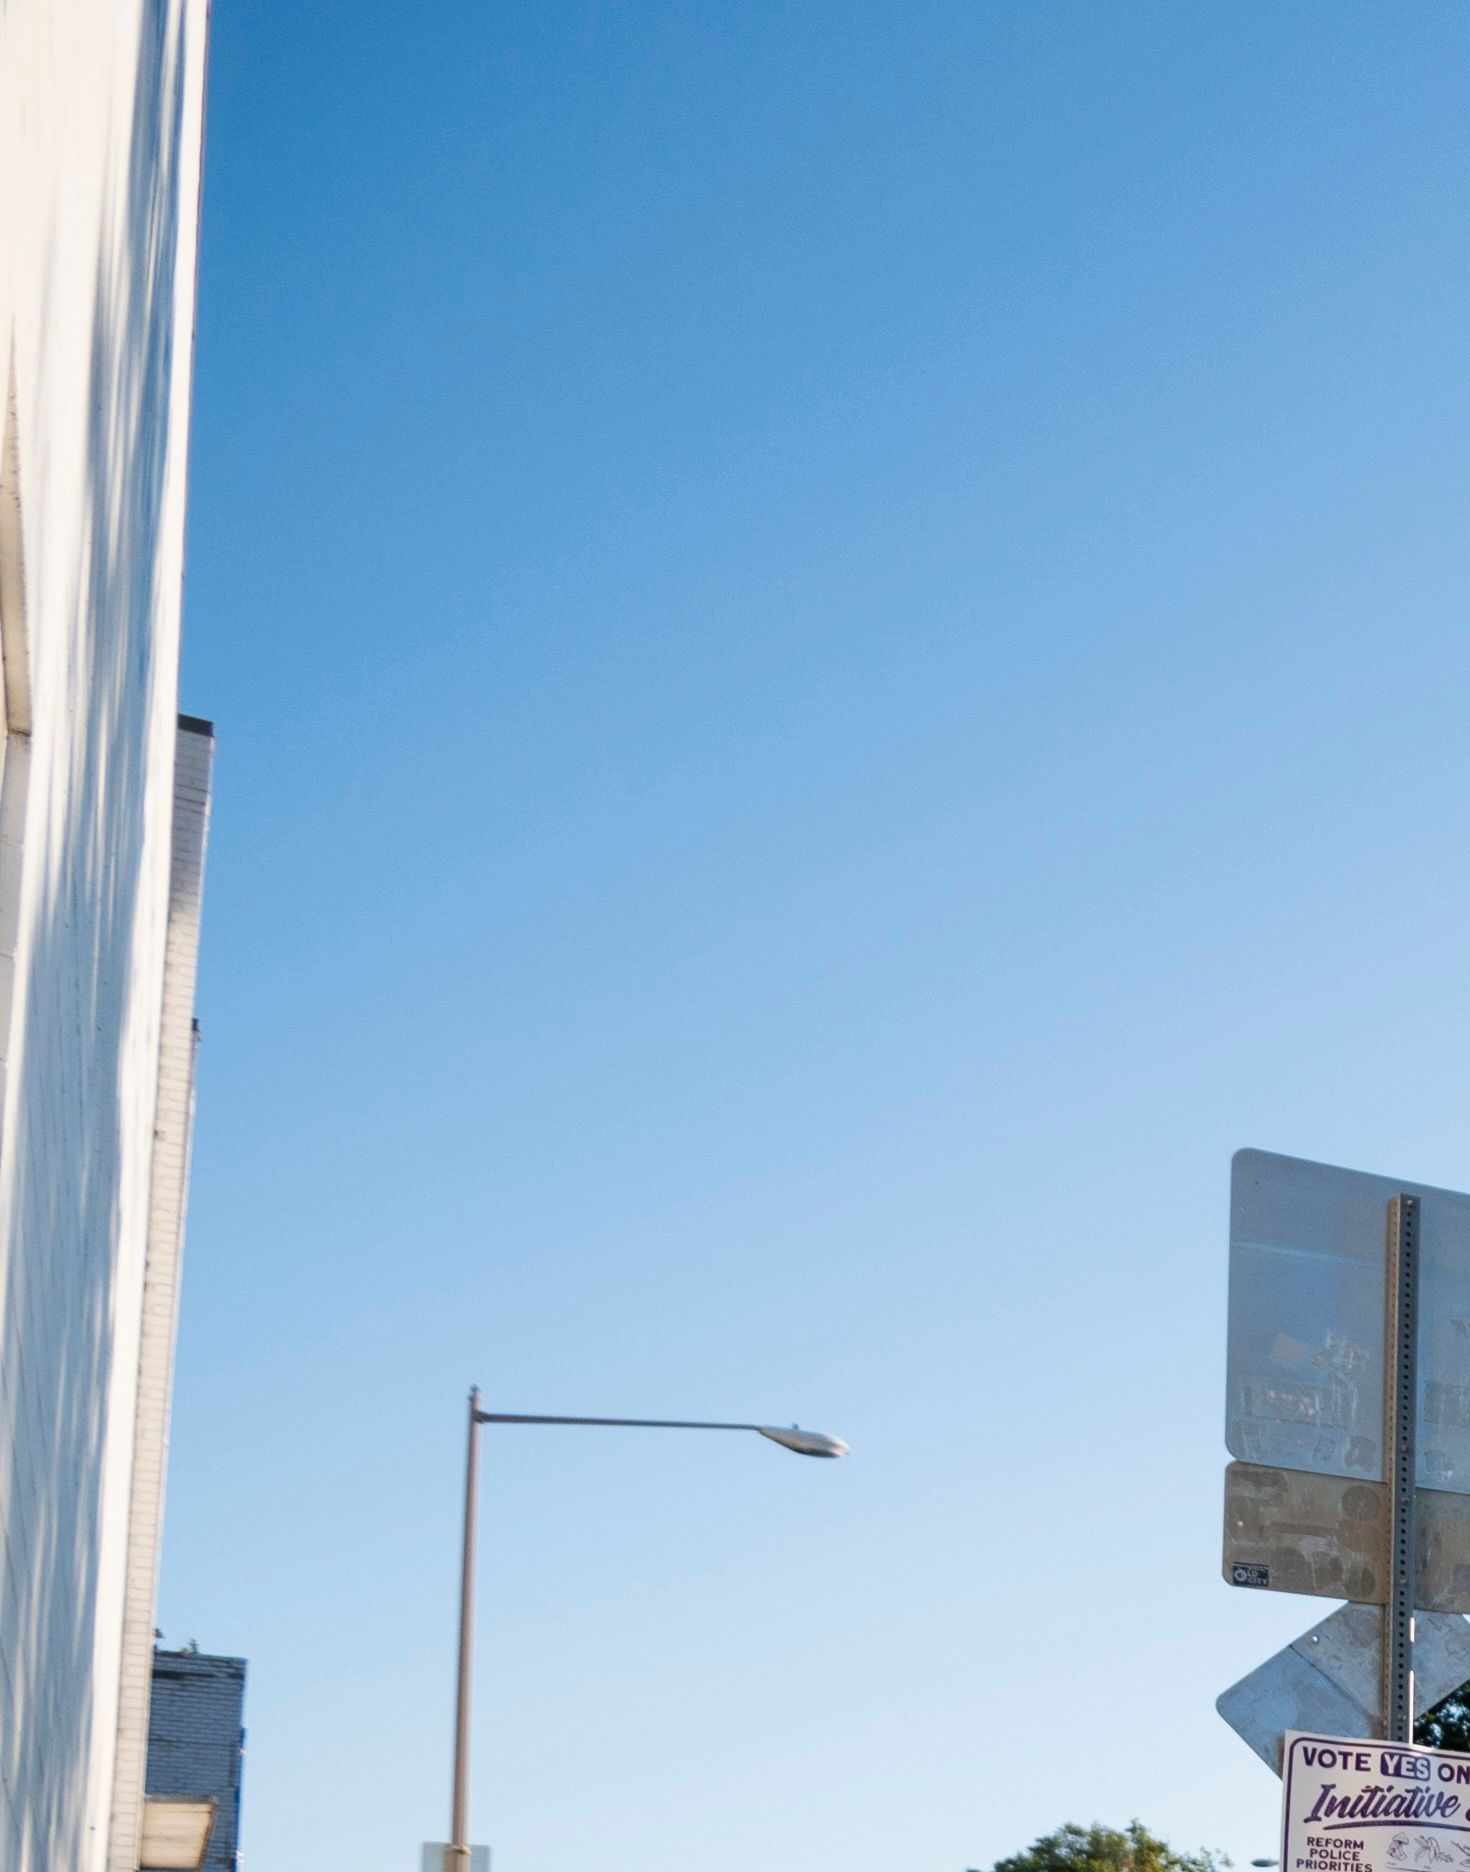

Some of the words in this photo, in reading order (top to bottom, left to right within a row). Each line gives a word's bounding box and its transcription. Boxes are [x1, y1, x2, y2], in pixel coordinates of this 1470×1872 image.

[1302, 1746, 1372, 1772] VOTE
[1383, 1753, 1430, 1780] YES
[1303, 1783, 1461, 1824] Initiative
[1306, 1836, 1365, 1850] REFORM
[1309, 1848, 1361, 1862] POLICE
